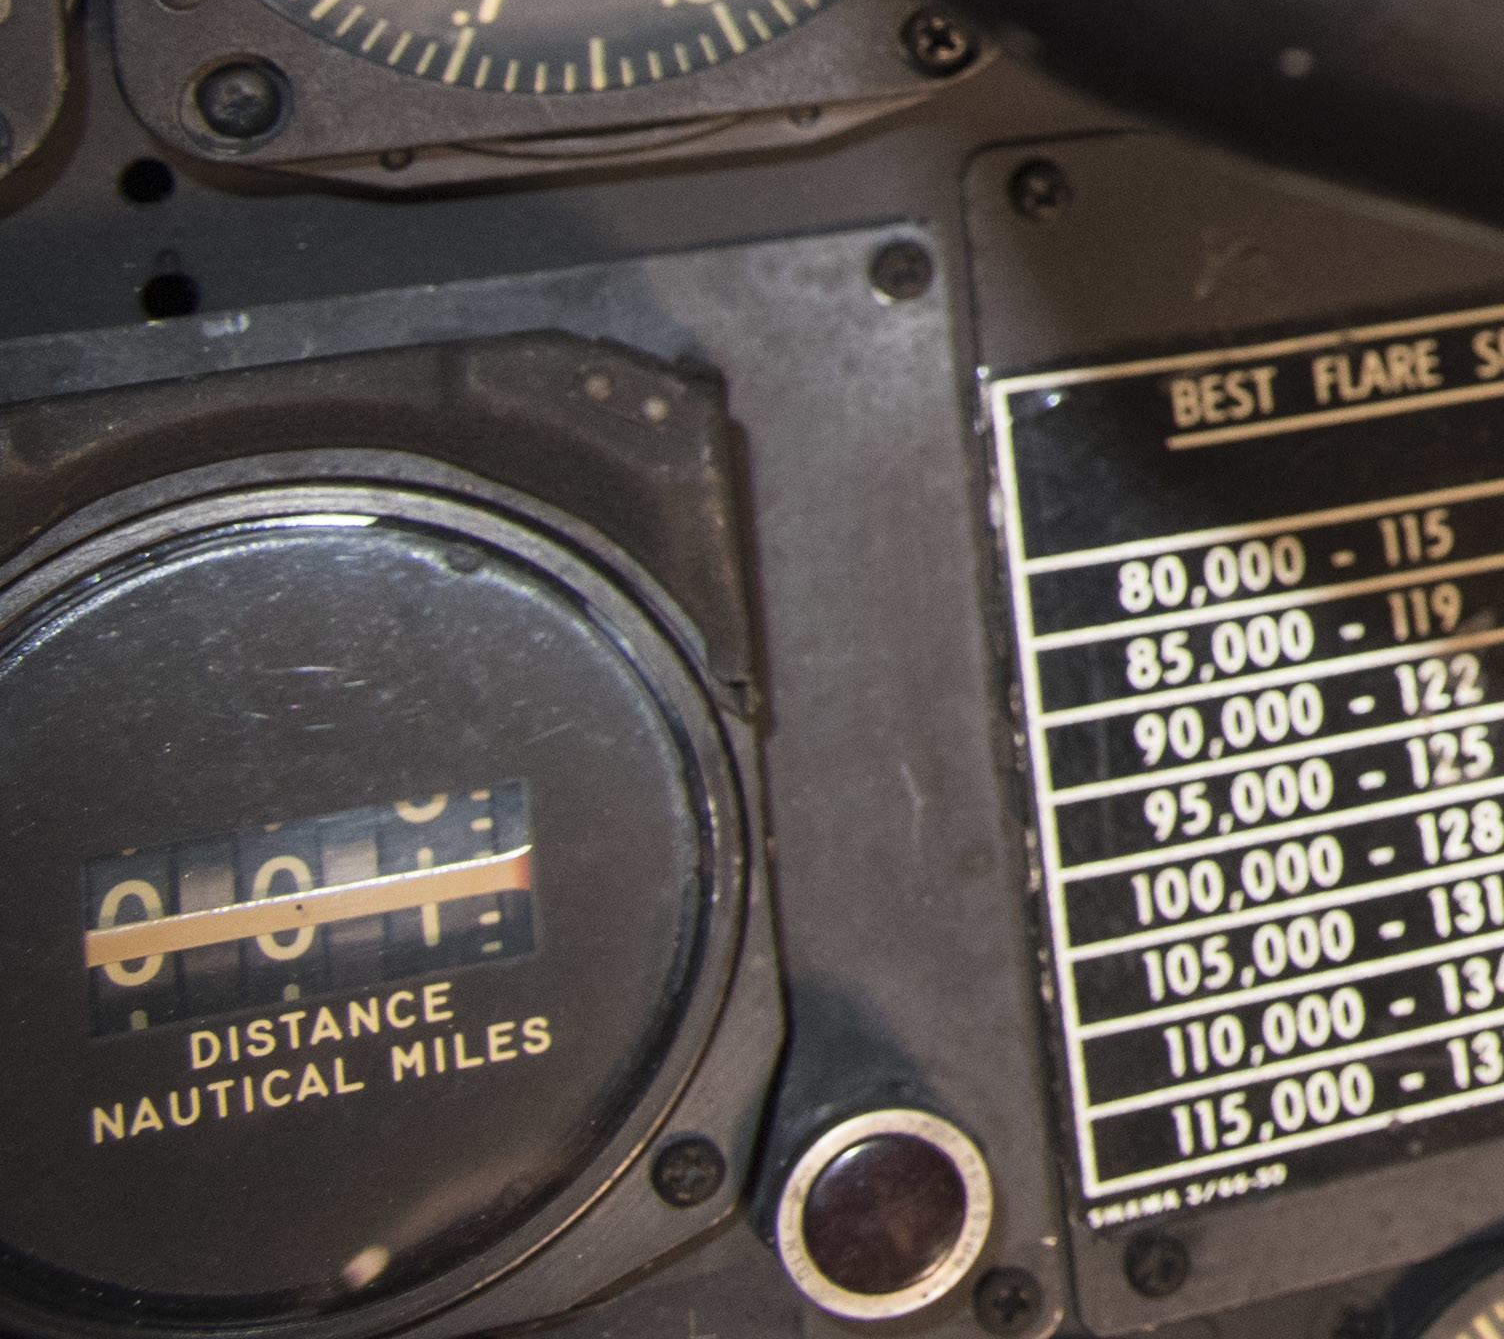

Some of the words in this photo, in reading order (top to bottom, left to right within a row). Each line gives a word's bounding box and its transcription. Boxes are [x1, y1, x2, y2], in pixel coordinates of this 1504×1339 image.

[1169, 367, 1278, 428] BEST
[1312, 338, 1443, 406] FLARE
[1118, 534, 1306, 614] 80,000
[1379, 507, 1455, 566] 115
[1125, 609, 1314, 690] 85,000
[1388, 582, 1462, 641] 119
[1133, 683, 1324, 767] 90,000
[1395, 652, 1484, 716] 122
[1144, 757, 1334, 841] 95,000
[1406, 725, 1495, 789] 125
[1132, 834, 1344, 926] 100,000
[1142, 909, 1355, 1001] 105,000
[189, 981, 455, 1071] DISTANCE
[1164, 986, 1365, 1078] 110,000
[90, 1058, 365, 1144] NAUTICAL
[391, 1017, 552, 1083] MILES
[1171, 1062, 1374, 1155] 115,000
